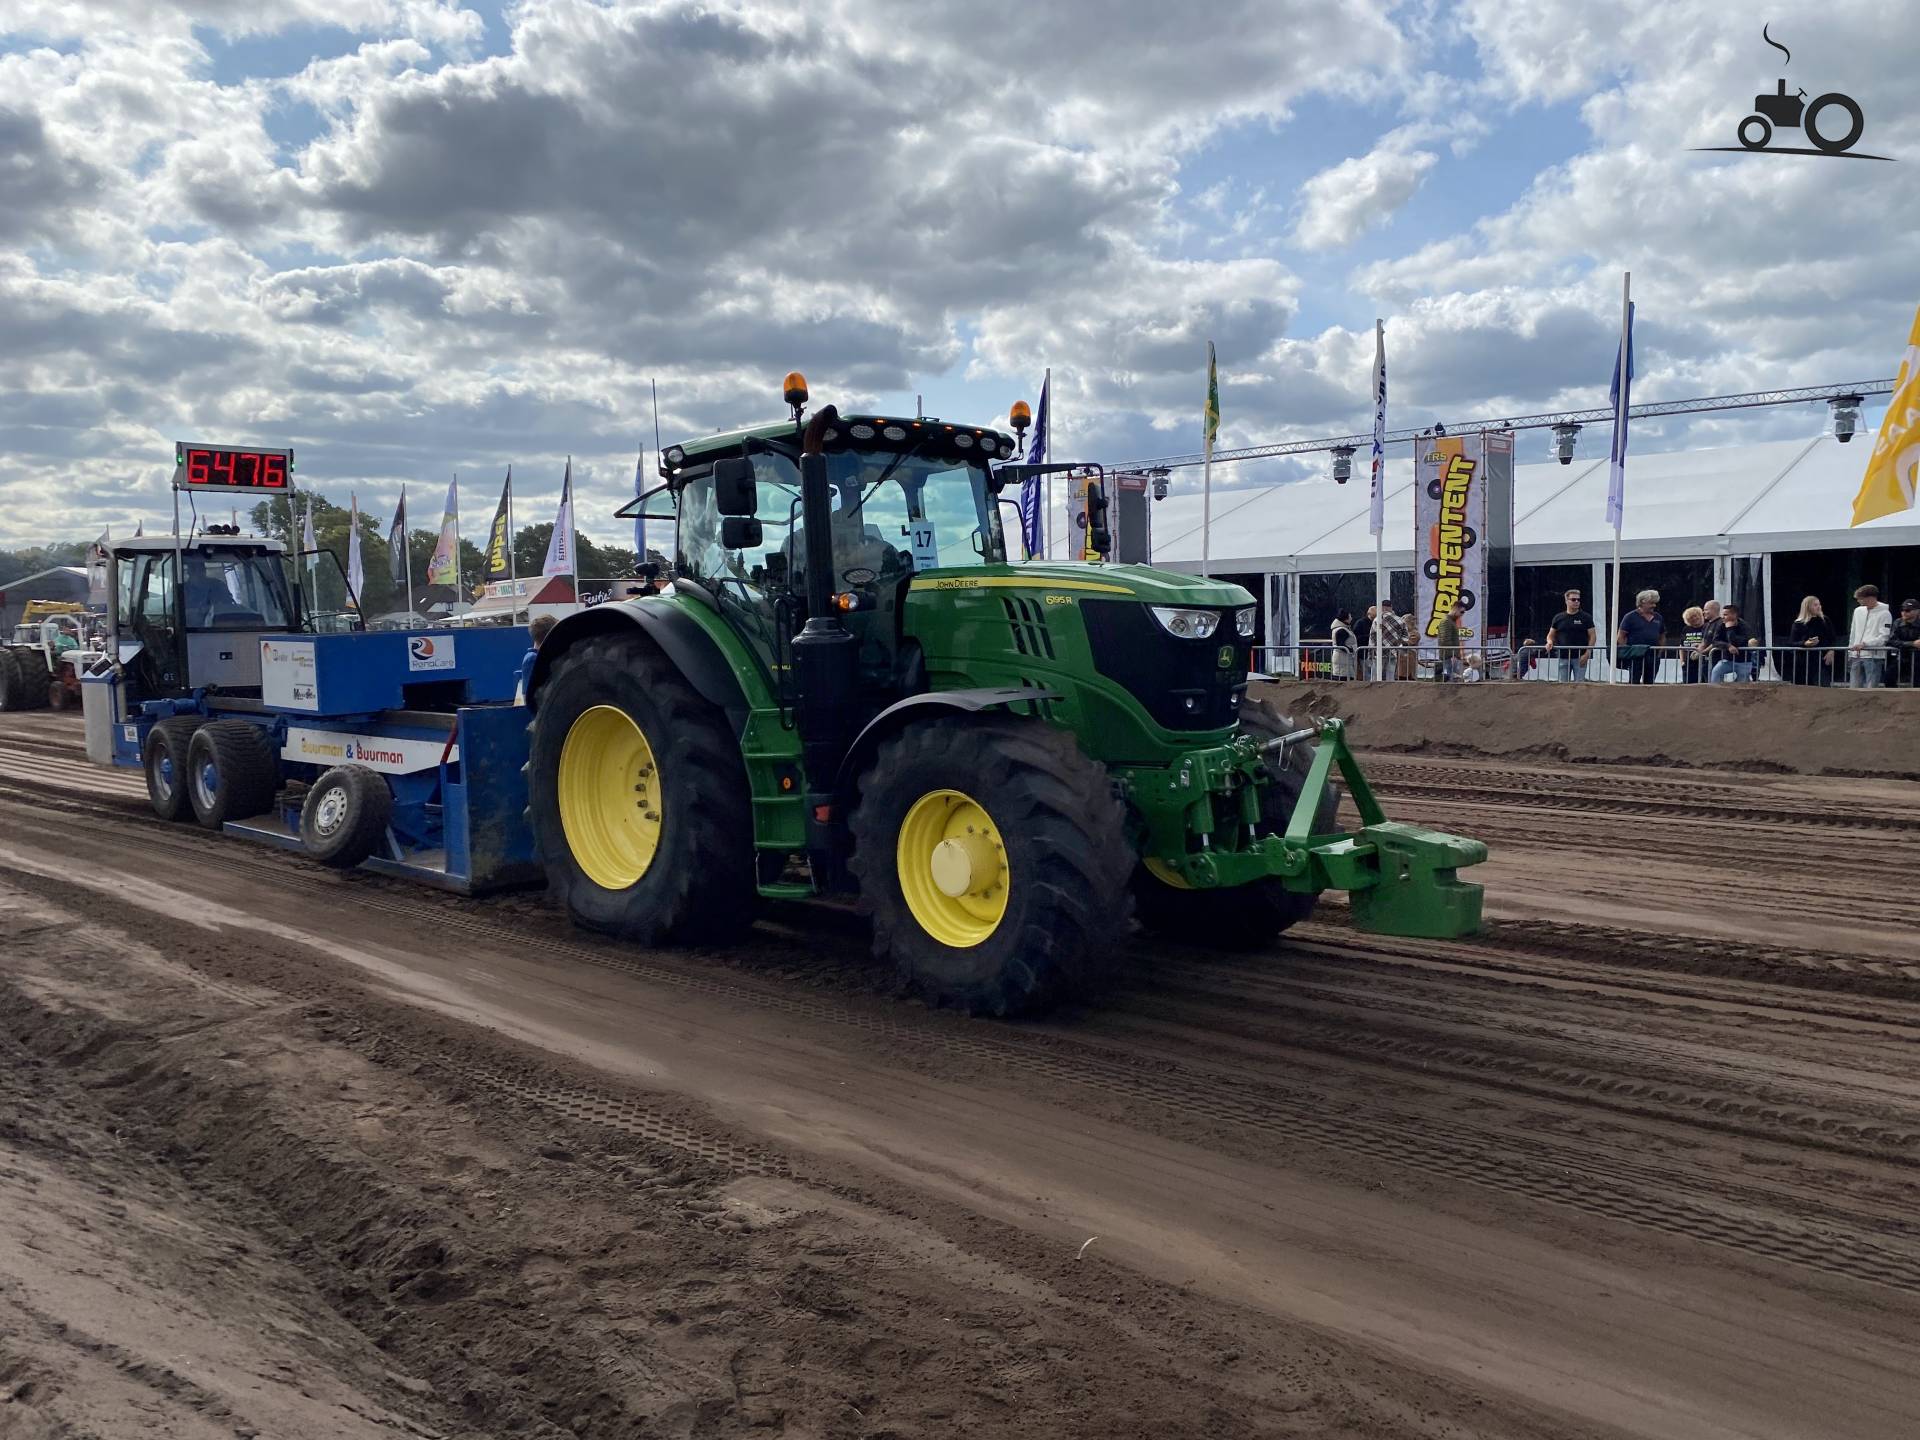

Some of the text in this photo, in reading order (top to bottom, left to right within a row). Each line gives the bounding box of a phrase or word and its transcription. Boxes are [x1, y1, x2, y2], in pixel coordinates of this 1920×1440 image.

[188, 450, 284, 486] 64.76
[915, 530, 931, 548] 17
[936, 579, 978, 589] JOHN DEERE
[1458, 628, 1474, 637] RS
[302, 740, 404, 764] Buurman & Buurman
